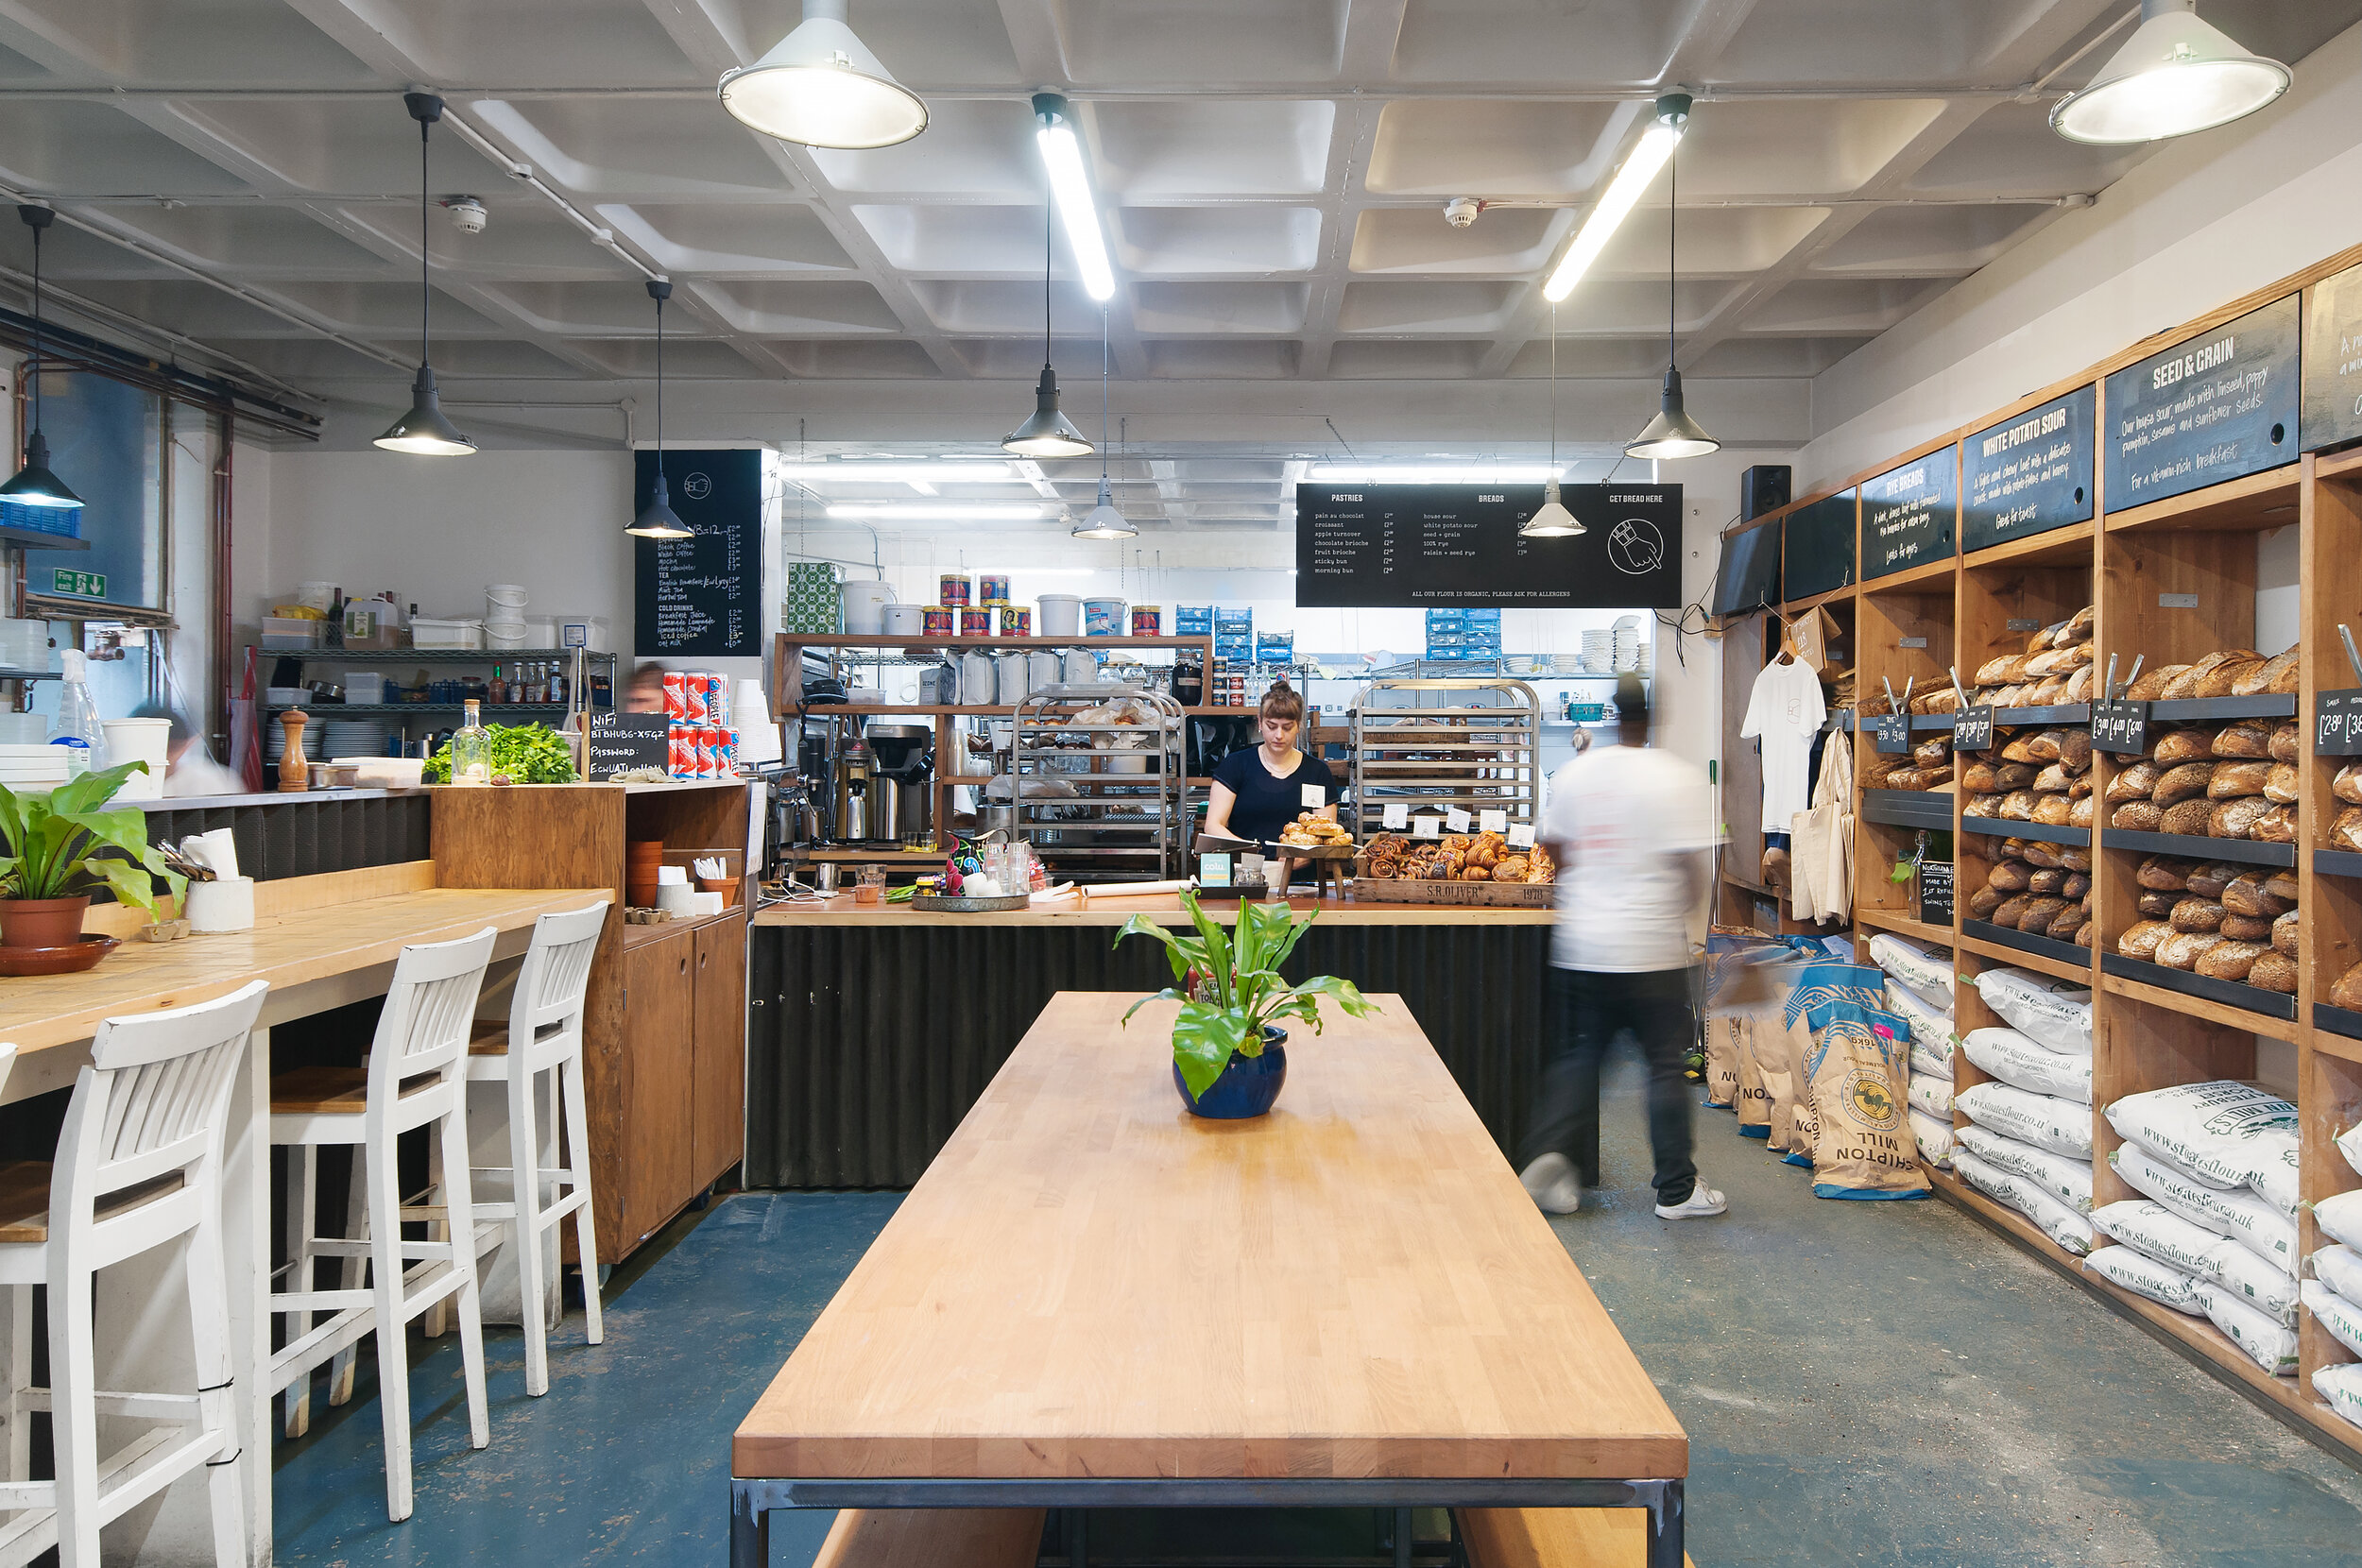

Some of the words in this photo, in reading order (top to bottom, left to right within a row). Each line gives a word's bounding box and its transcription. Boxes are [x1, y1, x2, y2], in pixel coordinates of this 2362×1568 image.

[2153, 358, 2183, 390] SEED
[2184, 354, 2196, 378] &
[2196, 336, 2235, 373] GRAIN
[2121, 419, 2135, 437] Our
[2135, 413, 2154, 431] house
[2174, 392, 2196, 415] made
[2197, 383, 2215, 405] with
[2217, 370, 2246, 398] linseed,
[2246, 366, 2268, 394] poppy
[1983, 430, 2009, 458] WHITE
[2009, 418, 2041, 449] POTATO
[2041, 407, 2066, 435] SOUR
[2122, 431, 2150, 458] pumpkin,
[2151, 422, 2176, 442] sesame
[2179, 415, 2193, 432] and
[2196, 403, 2232, 428] sunflower
[1991, 466, 2001, 483] and
[2020, 455, 2030, 474] loaf
[2030, 453, 2042, 469] with
[2048, 441, 2071, 462] delicate
[2131, 471, 2142, 491] For
[2143, 476, 2149, 486] a
[2196, 443, 2238, 470] breakfast
[1886, 477, 1899, 498] RYE
[1899, 467, 1925, 492] BREADS
[2041, 466, 2051, 483] and
[1331, 494, 1363, 503] PASTRIES
[1479, 494, 1505, 503] BREADS
[1609, 494, 1622, 503] GET
[1622, 494, 1645, 503] BREAD
[1645, 494, 1664, 503] HERE
[2010, 507, 2019, 526] for
[2018, 503, 2038, 522] toast
[57, 571, 73, 582] Fire
[57, 583, 72, 591] exit
[1427, 885, 1480, 898] S.R.OLIVER
[1851, 1036, 1876, 1047] 16kg
[1857, 1133, 1899, 1151] MILL
[1837, 1149, 1914, 1170] SHIPTON
